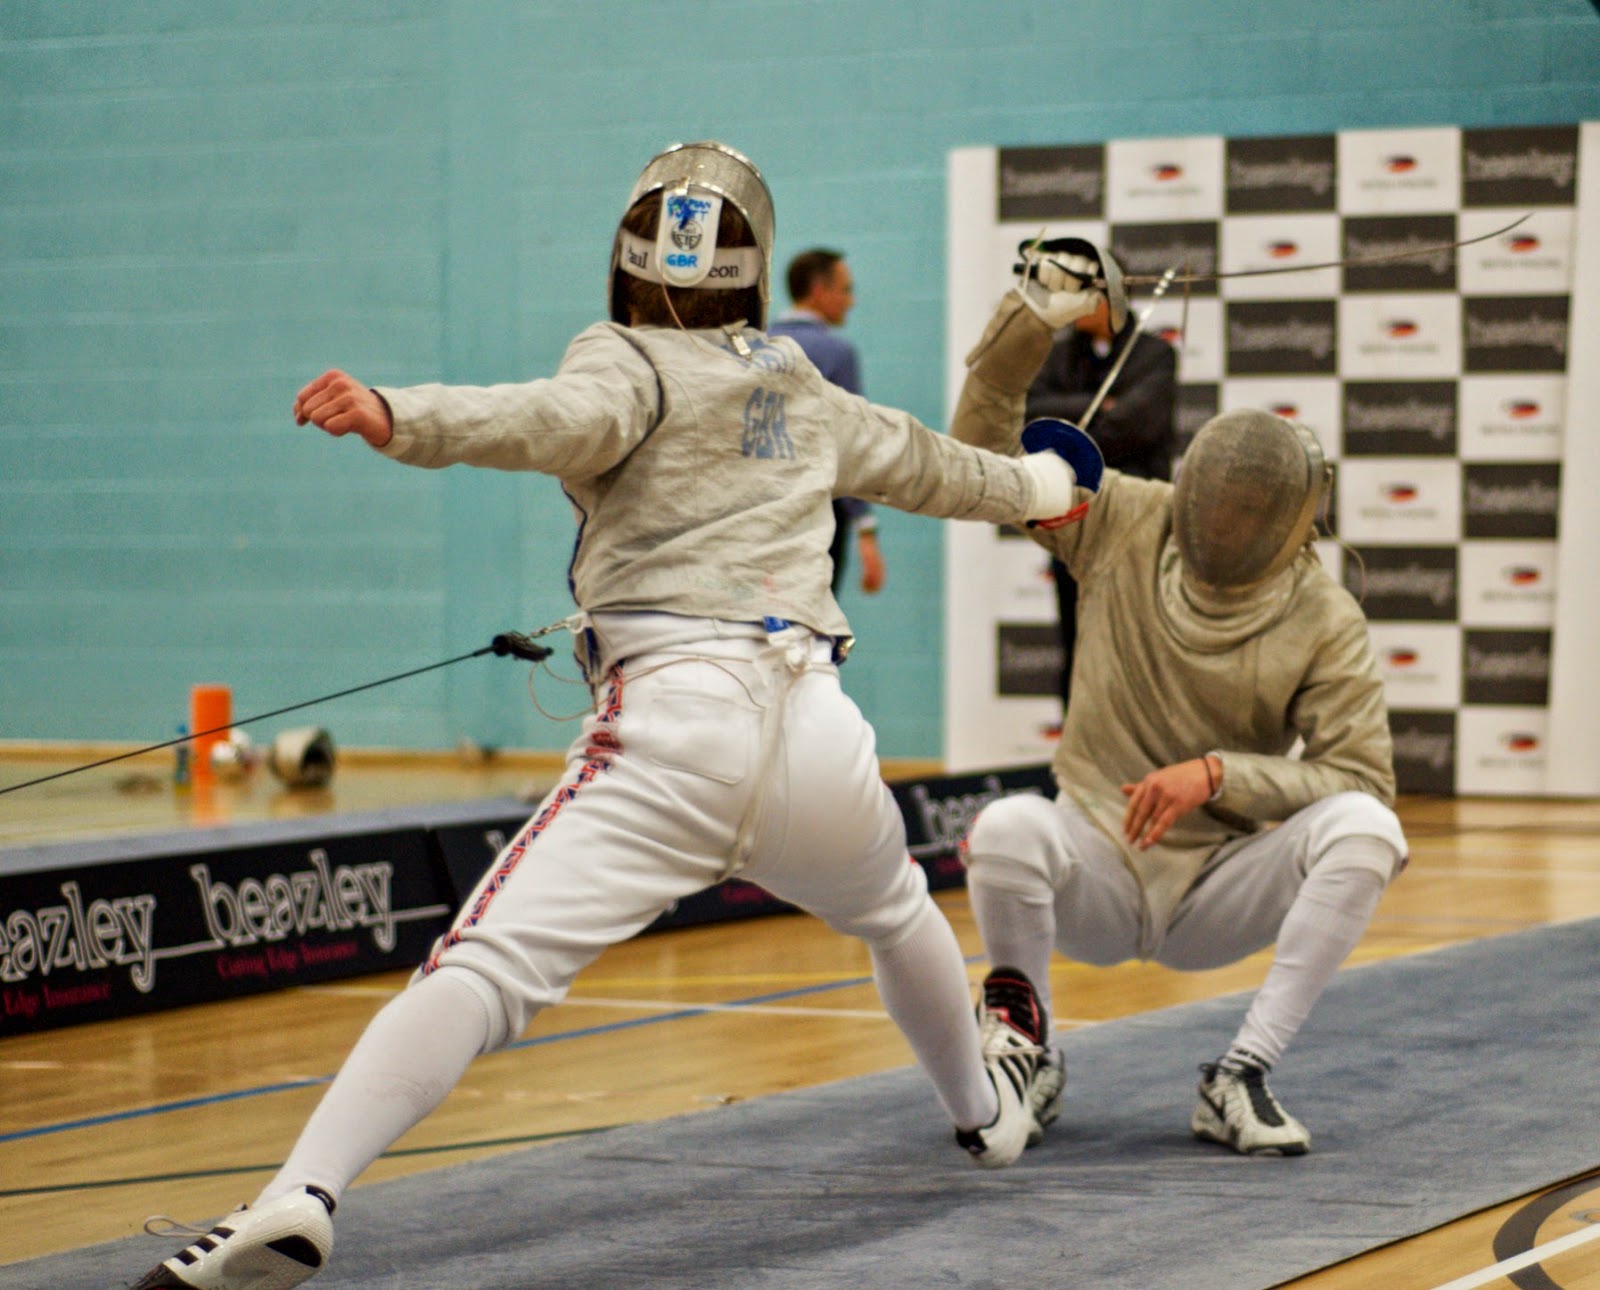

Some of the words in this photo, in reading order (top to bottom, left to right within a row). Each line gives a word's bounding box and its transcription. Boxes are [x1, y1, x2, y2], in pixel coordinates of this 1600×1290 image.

[628, 247, 648, 270] aul
[665, 253, 699, 269] GBR
[707, 264, 740, 279] eon
[189, 848, 394, 953] beazley
[0, 880, 157, 993] azley
